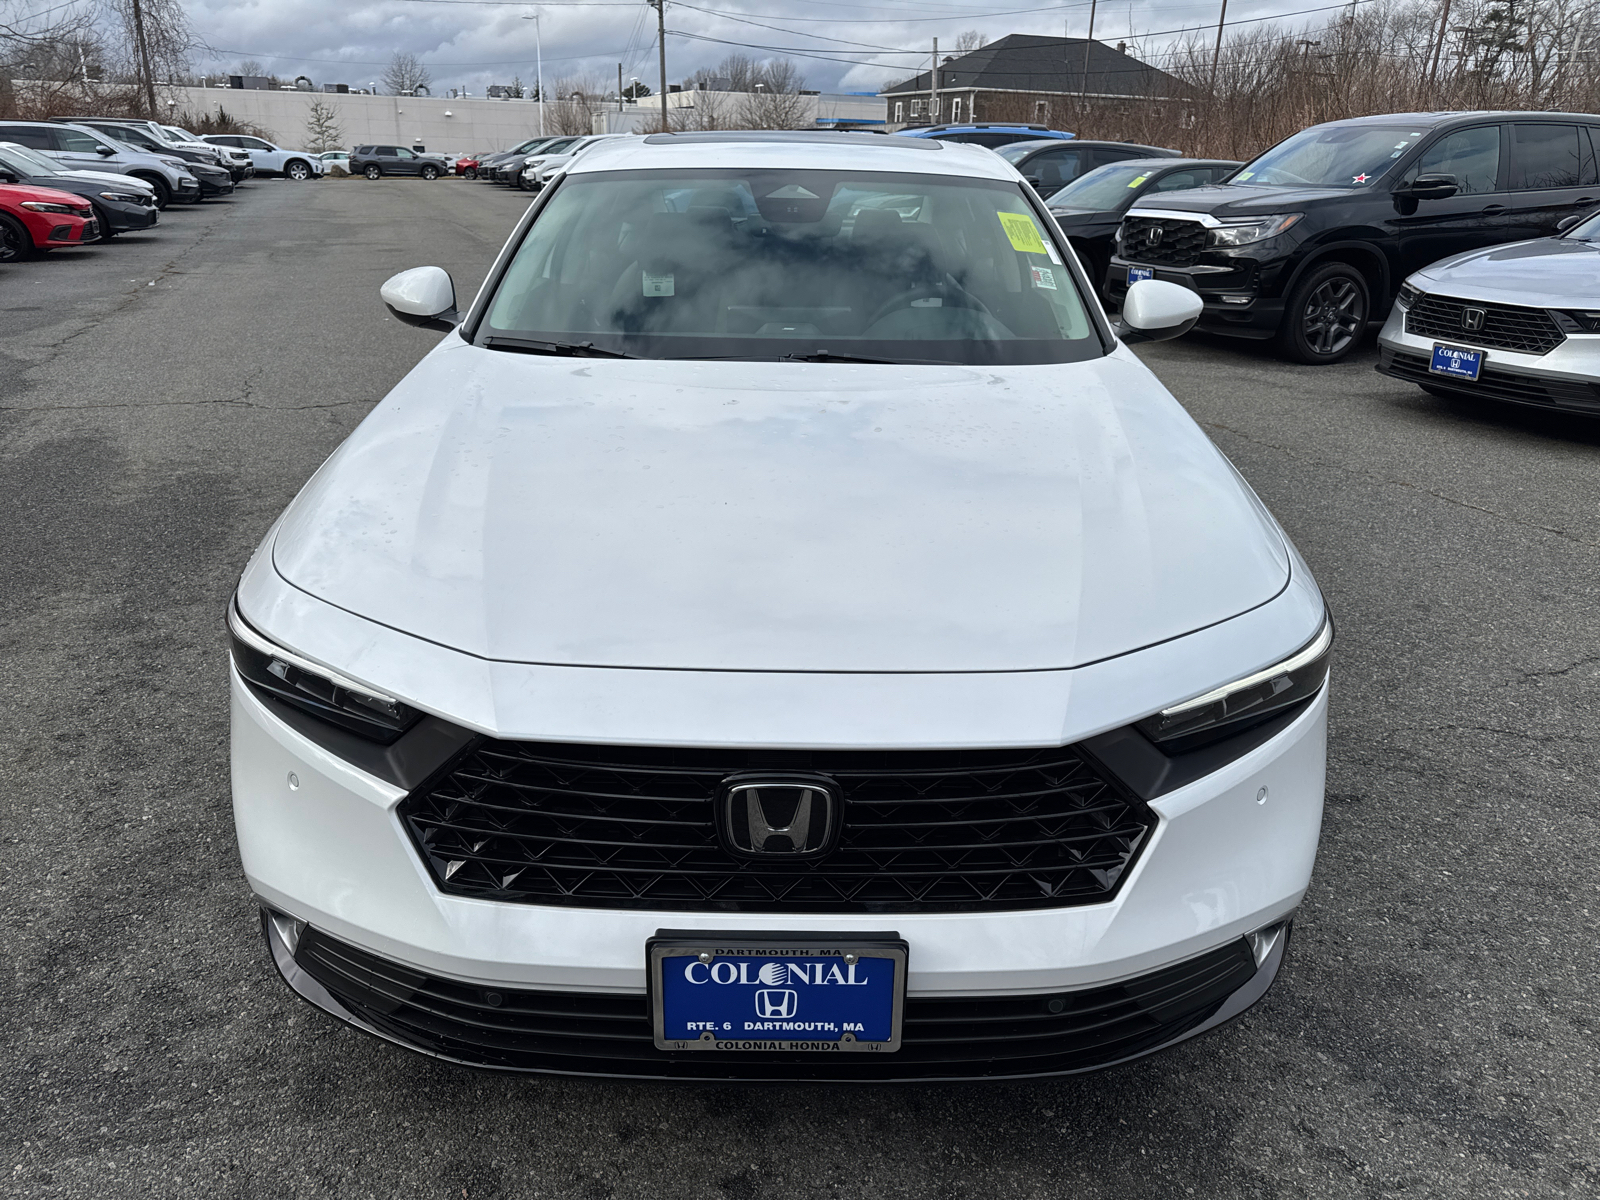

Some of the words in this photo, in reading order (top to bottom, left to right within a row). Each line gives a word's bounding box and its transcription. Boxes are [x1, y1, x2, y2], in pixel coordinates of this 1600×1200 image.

[1438, 349, 1476, 362] COLONIAL
[715, 949, 814, 957] DARTMOUTH,
[684, 961, 869, 986] COLONIAL
[687, 1022, 719, 1031] RTE.
[723, 1022, 732, 1031] 6
[744, 1022, 838, 1032] DARTMOUTH,
[843, 1022, 864, 1032] MA
[715, 1041, 787, 1051] COLONIAL
[790, 1041, 841, 1051] HONDA
